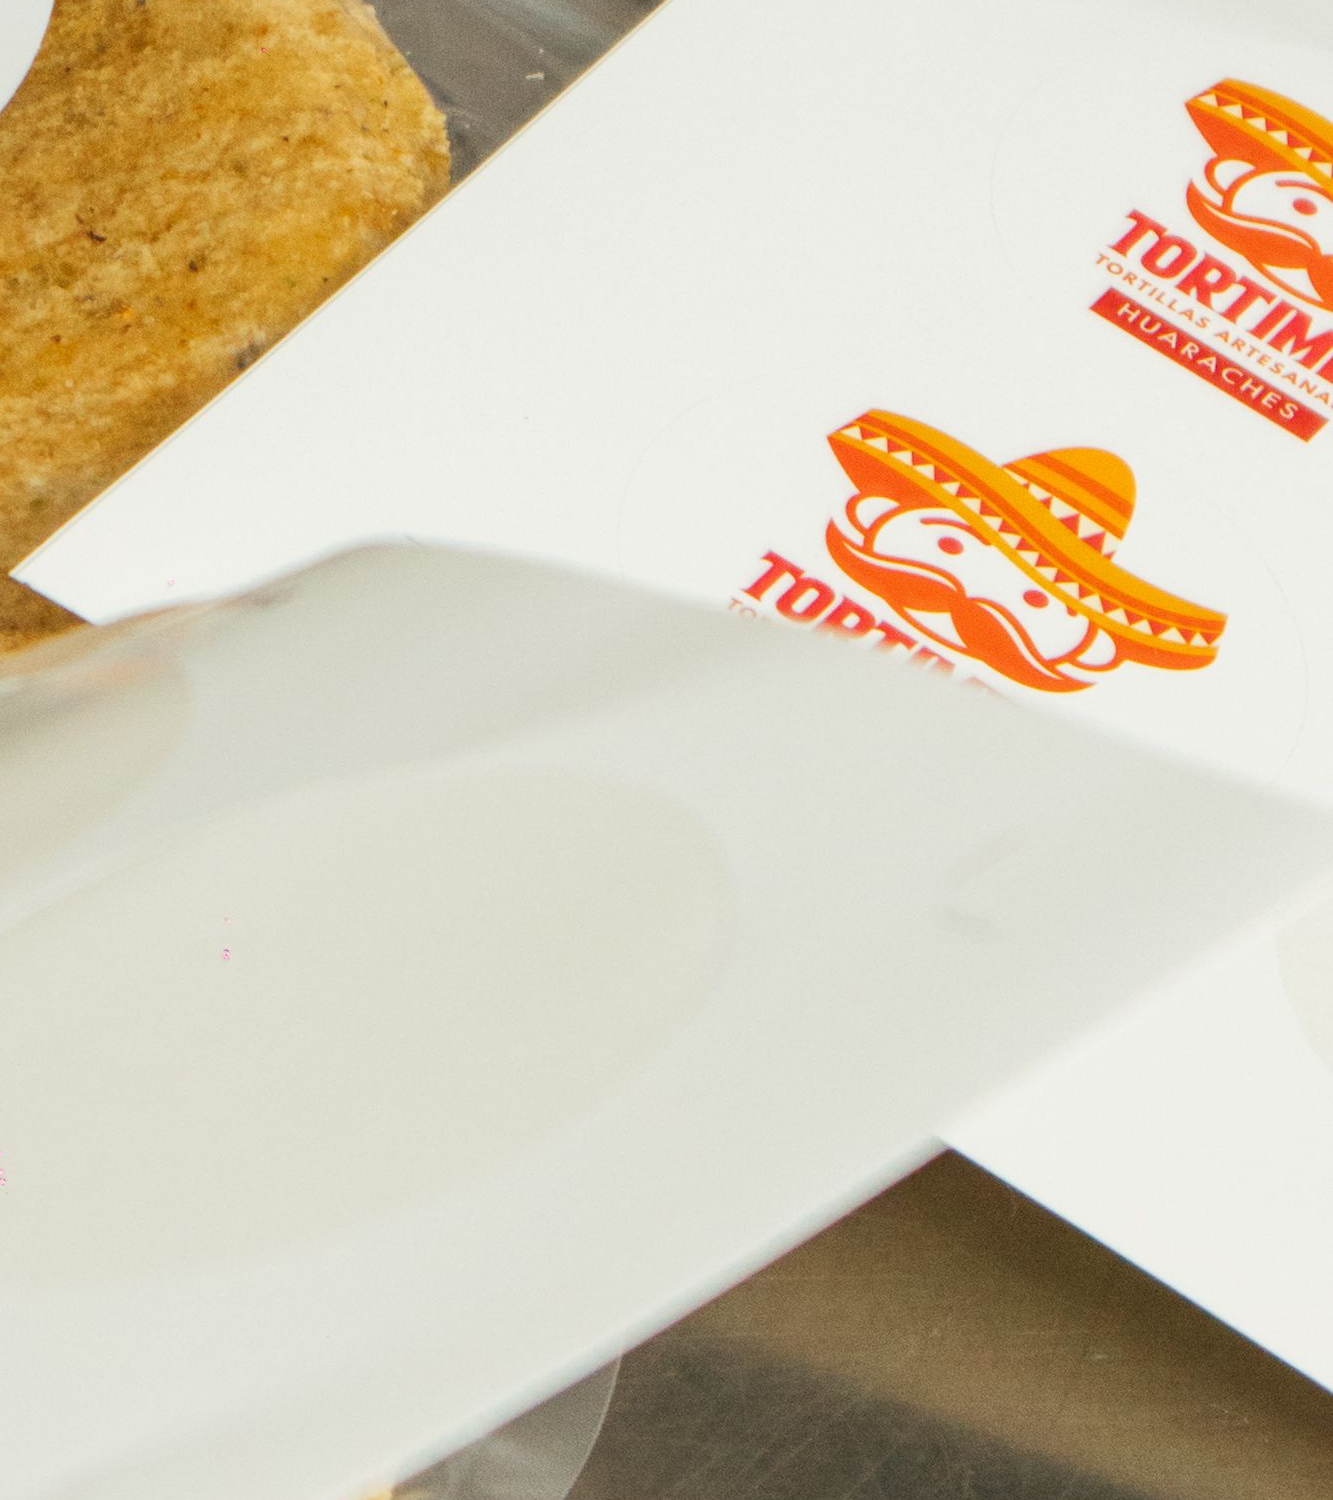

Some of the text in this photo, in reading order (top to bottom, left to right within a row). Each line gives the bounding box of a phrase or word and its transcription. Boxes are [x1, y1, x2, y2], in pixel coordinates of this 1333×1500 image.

[1095, 253, 1333, 410] TORTILLAS ARTESANA
[1107, 208, 1333, 387] TORTIM
[1116, 302, 1299, 421] HUARACHES
